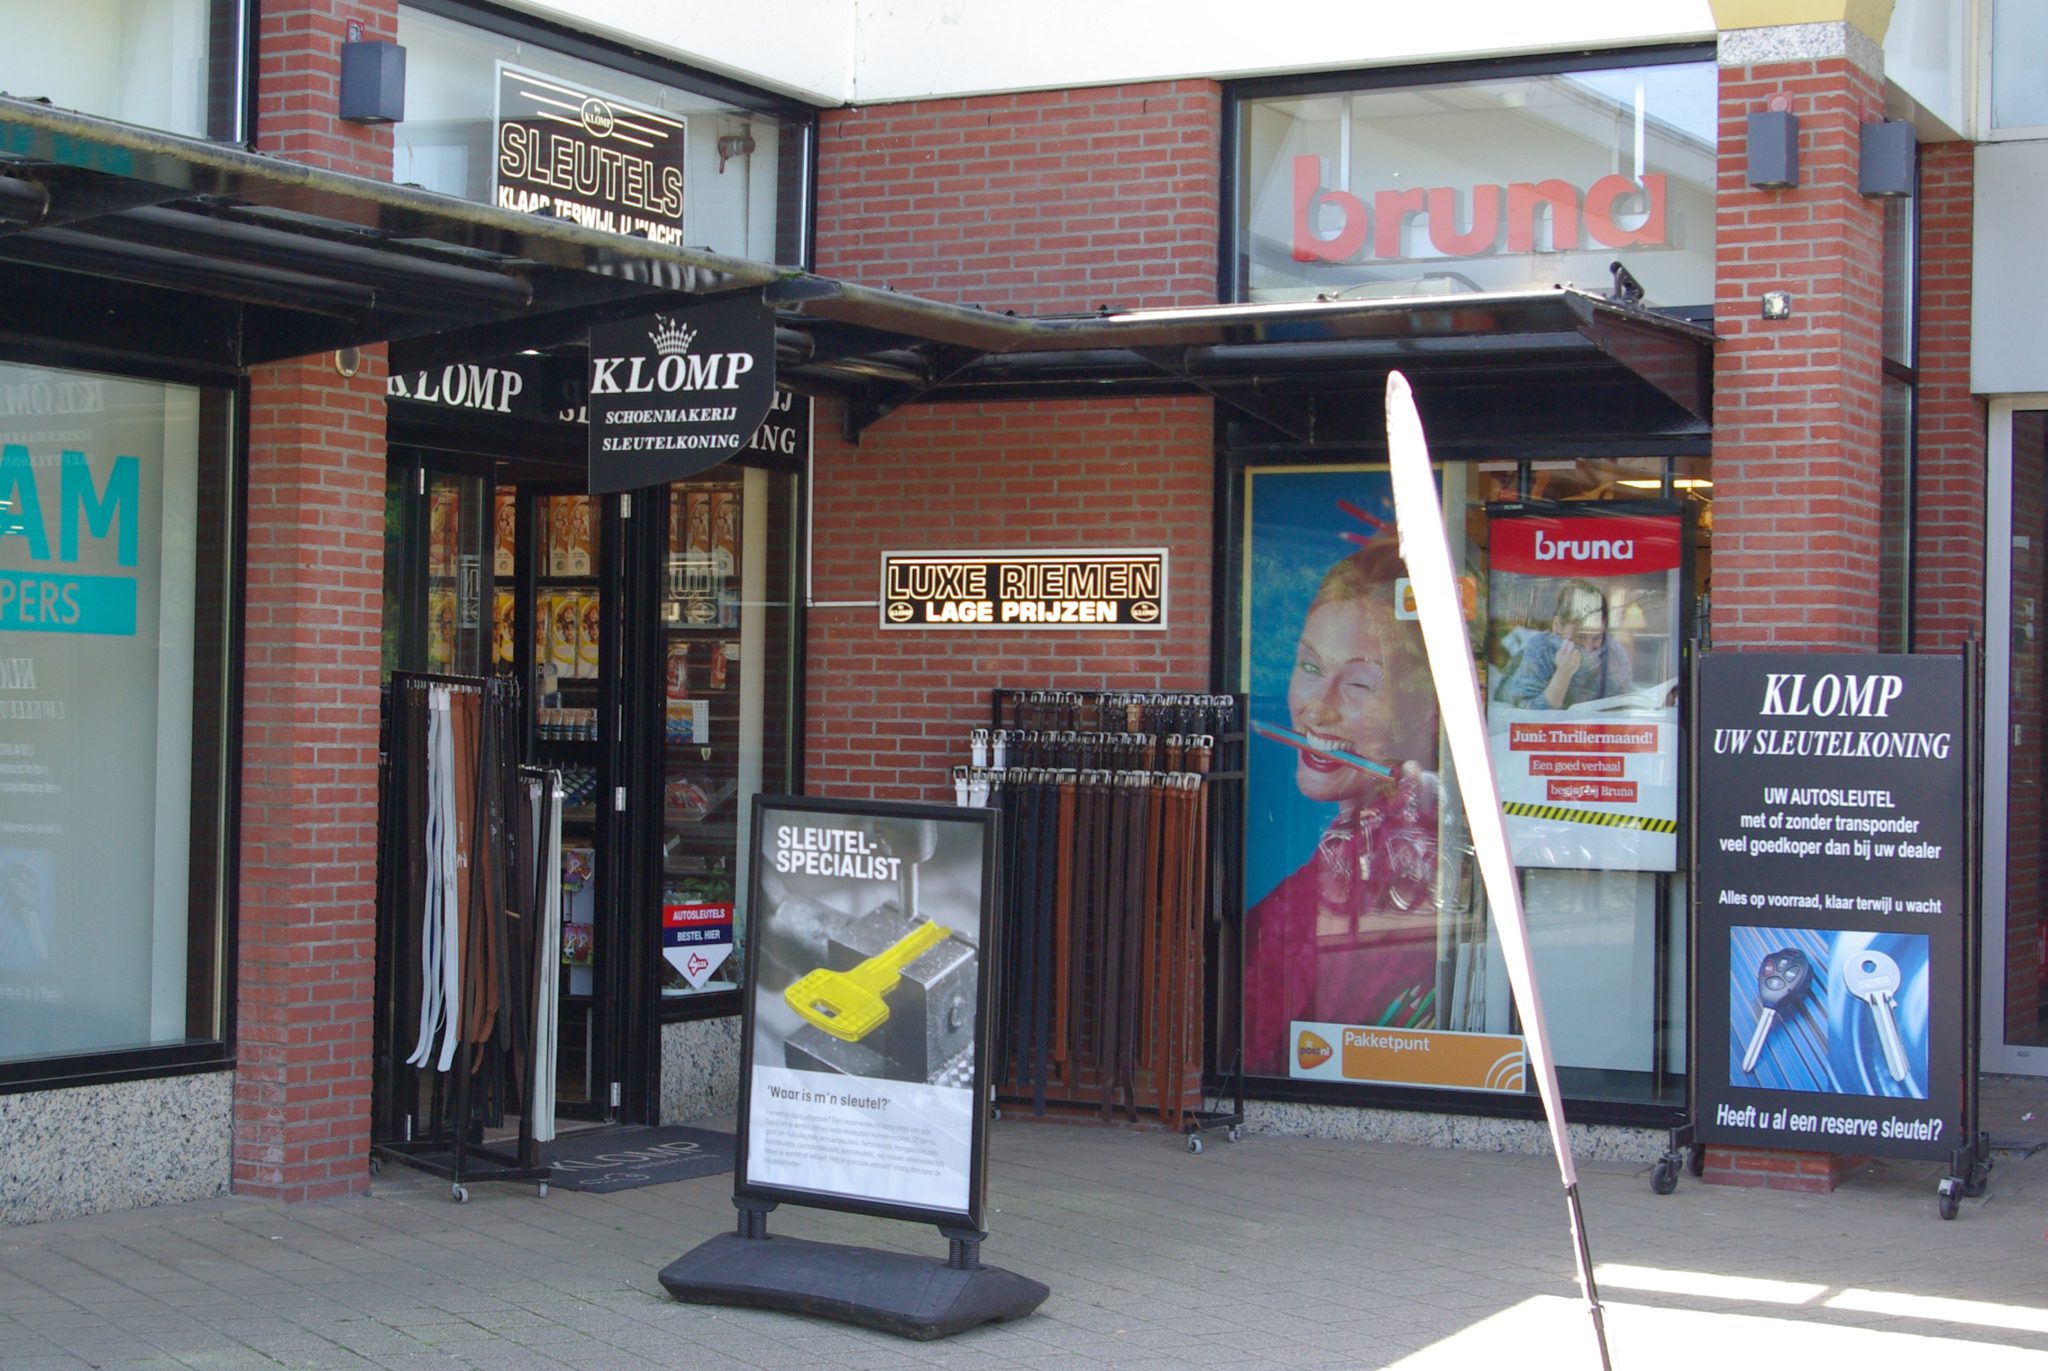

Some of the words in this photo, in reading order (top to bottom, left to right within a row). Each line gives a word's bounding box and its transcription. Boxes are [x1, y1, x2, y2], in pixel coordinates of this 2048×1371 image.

[585, 111, 611, 129] KLOMP
[501, 122, 684, 218] SLEUTELS
[1293, 154, 1666, 263] bruna
[621, 214, 632, 235] U
[590, 352, 754, 395] KLOMP
[605, 407, 738, 425] SCHOENMAKERIJ
[602, 434, 741, 452] SLEUTELKONING
[0, 443, 139, 567] AM
[1535, 530, 1634, 560] bruna
[888, 565, 987, 600] LUXE
[1000, 563, 1160, 600] RIEMEN
[0, 579, 80, 624] PERS
[926, 601, 994, 622] LAGE
[1001, 601, 1118, 622] PRIJZEN
[1760, 673, 1903, 718] KLOMP
[1513, 730, 1546, 743] Juni:
[1549, 730, 1653, 744] Thrillermaand!
[1713, 729, 1752, 754] UW
[1753, 729, 1951, 760] SLEUTELKONING
[1533, 760, 1553, 771] Een
[1554, 760, 1580, 773] goed
[1581, 761, 1621, 772] verhaal
[1601, 785, 1634, 797] Bruna
[1764, 787, 1788, 805] UW
[1790, 788, 1895, 808] AUTOSLEUTEL
[1740, 813, 1766, 829] met
[1769, 812, 1783, 829] of
[1785, 813, 1832, 831] zonder
[1836, 814, 1919, 836] transponder
[777, 826, 878, 855] SLEUTEL-
[1719, 836, 1747, 852] veel
[1750, 837, 1822, 859] goedkoper
[1825, 839, 1850, 856] dan
[1854, 840, 1871, 861] bij
[1874, 844, 1895, 858] uw
[1898, 841, 1941, 859] dealer
[776, 850, 901, 881] SPECIALIST
[1719, 890, 1747, 905] Alles
[1750, 894, 1765, 909] op
[1767, 893, 1823, 911] voorraad,
[1825, 894, 1854, 909] klaar
[1856, 895, 1892, 914] terwijl
[1895, 900, 1903, 912] u
[1905, 897, 1941, 913] wacht
[672, 908, 726, 921] AUTOSLEUTELS
[677, 931, 703, 942] BESTEL
[704, 929, 720, 940] HIER
[1345, 1032, 1430, 1052] Pakketpunt
[802, 1089, 812, 1103] is
[1717, 1104, 1757, 1128] Heeft
[1759, 1111, 1770, 1129] u
[1772, 1107, 1786, 1130] al
[1790, 1112, 1817, 1132] een
[1821, 1114, 1878, 1137] reserve
[1882, 1116, 1943, 1141] sleutel?
